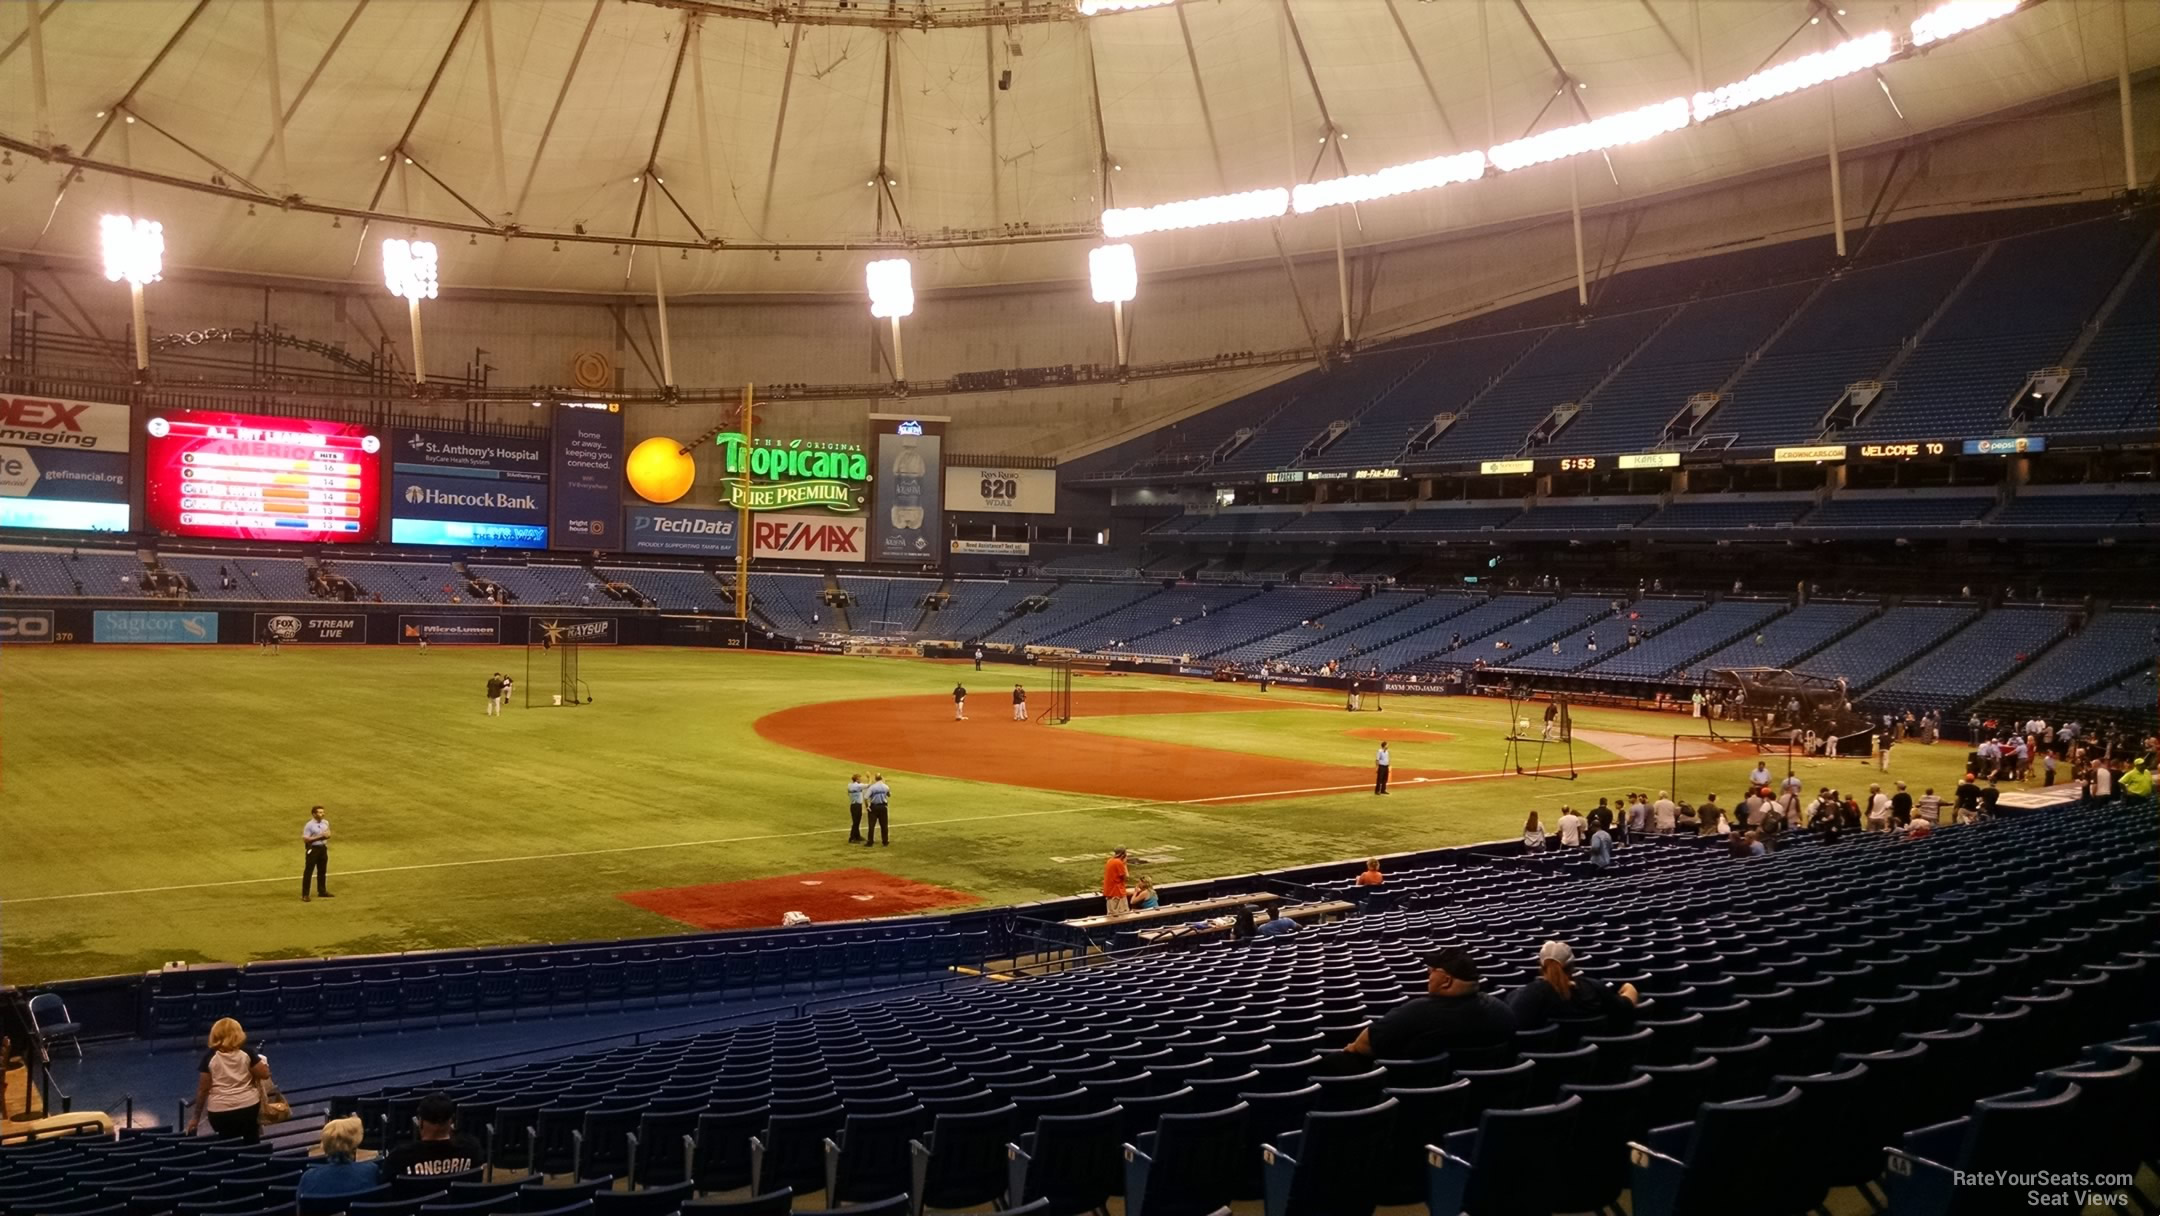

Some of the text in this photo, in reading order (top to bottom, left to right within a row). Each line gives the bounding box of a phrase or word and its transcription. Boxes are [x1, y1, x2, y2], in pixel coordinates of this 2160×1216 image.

[578, 429, 600, 439] home
[807, 442, 861, 451] ORIGINAL
[1861, 443, 1943, 456] WELCOME TO
[1991, 441, 2015, 450] pepsi
[426, 442, 539, 461] St. Anthony's Hospital
[565, 448, 597, 459] keeping
[716, 432, 867, 480] Tropicana
[450, 456, 469, 464] Health
[568, 460, 610, 469] connected.
[1561, 458, 1596, 470] 5:53
[324, 464, 334, 472] 16
[45, 470, 124, 485] gtefinancial.org
[324, 478, 334, 486] 14
[1266, 473, 1279, 482] FLEX
[980, 479, 1017, 499] 620
[324, 493, 334, 501] 14
[426, 489, 537, 509] Hancock Bank
[777, 485, 848, 504] PREMIUM
[986, 499, 1012, 507] WDAE
[323, 507, 333, 515] 13
[322, 521, 333, 529] 13
[569, 519, 588, 527] bright
[106, 613, 176, 634] Sagicor
[275, 619, 295, 628] FOX
[308, 620, 354, 628] STREAM
[56, 633, 73, 641] 370
[320, 630, 343, 638] LIVE
[728, 638, 740, 646] 322
[1385, 684, 1445, 693] RAYMOND JAMES
[406, 1158, 472, 1175] LONGORIA
